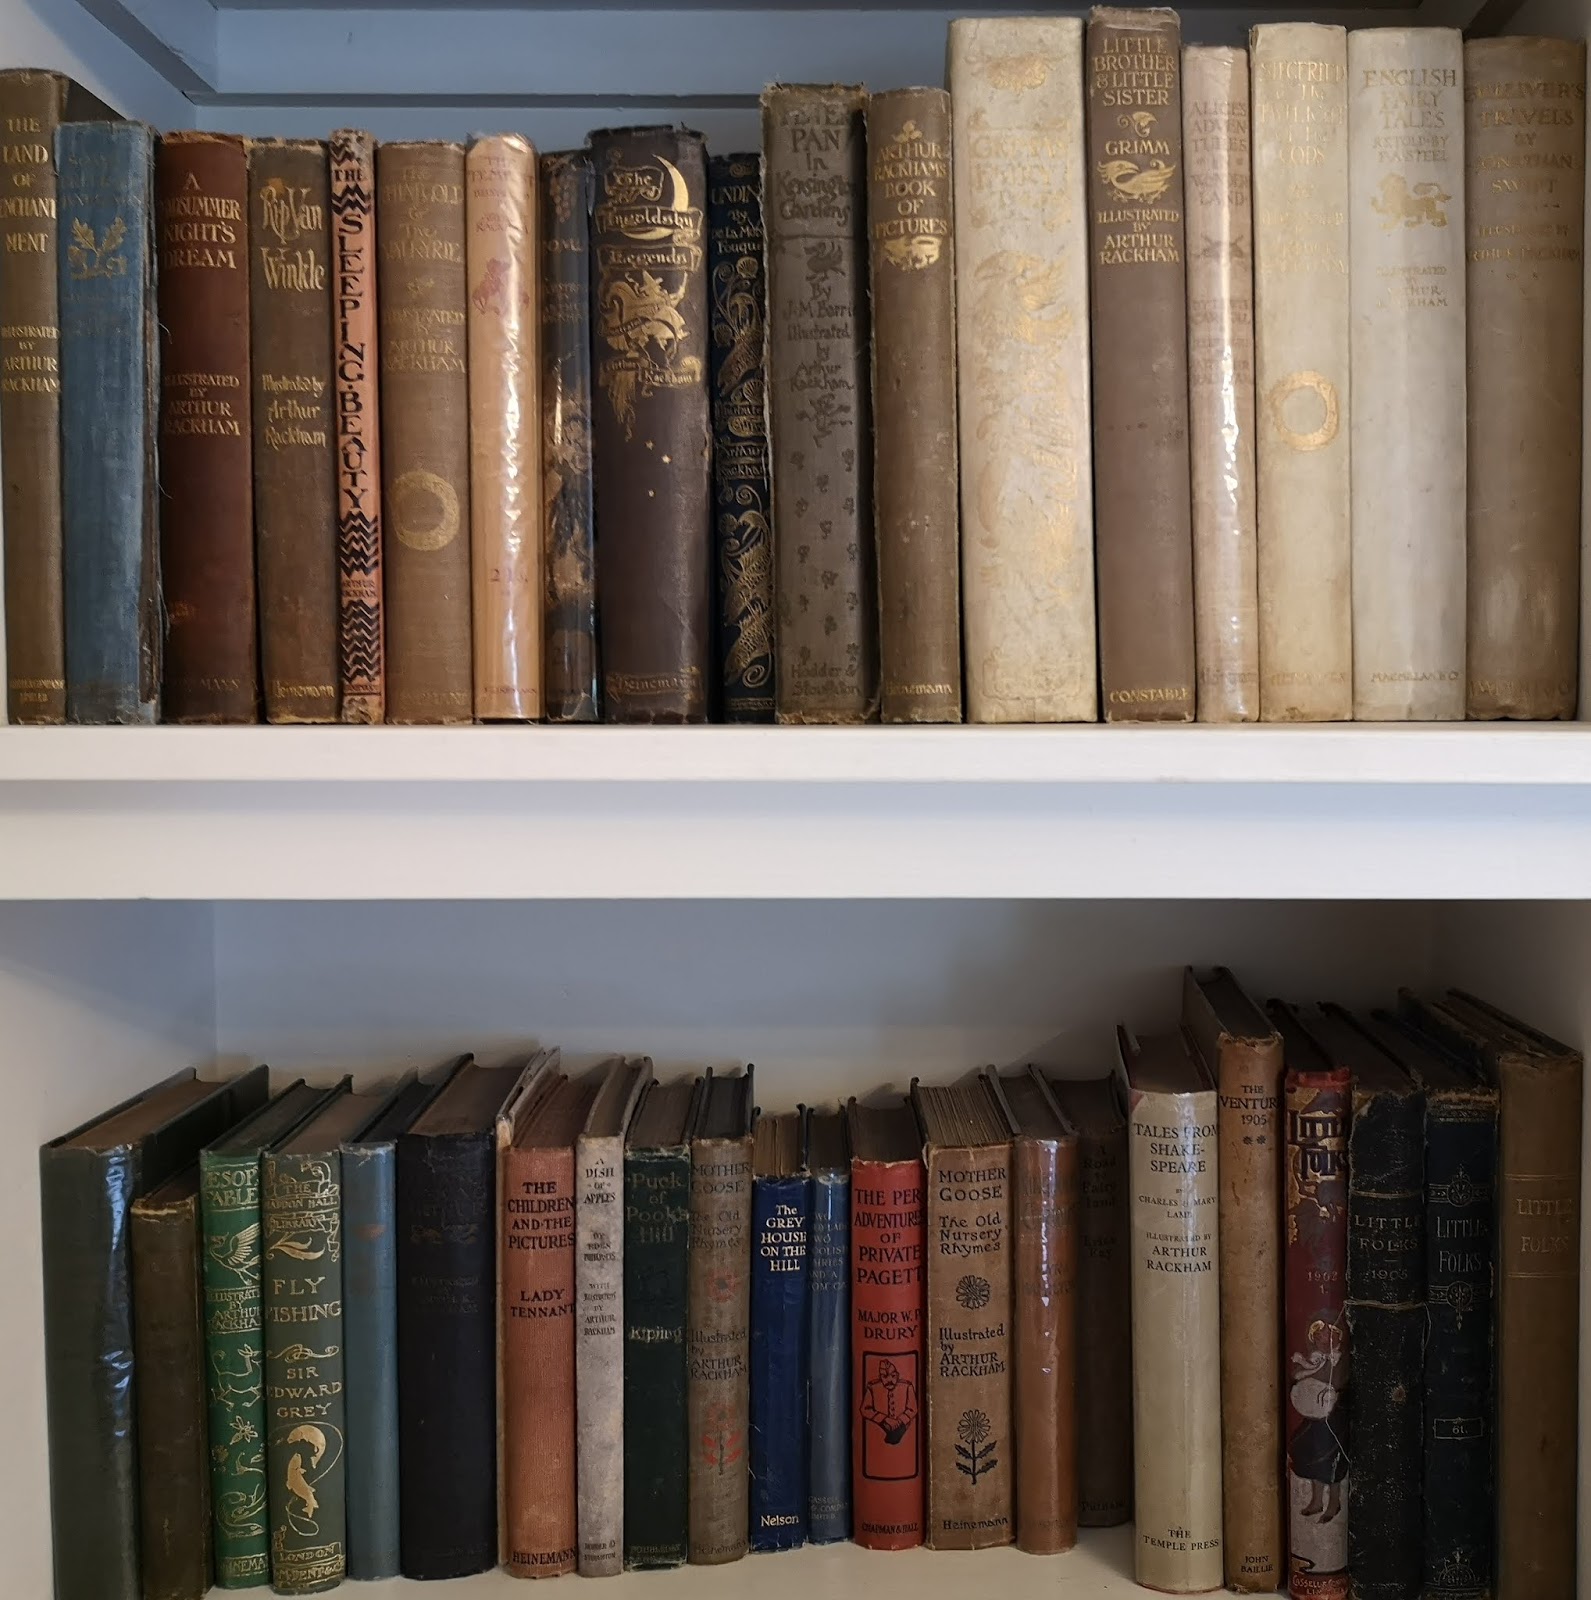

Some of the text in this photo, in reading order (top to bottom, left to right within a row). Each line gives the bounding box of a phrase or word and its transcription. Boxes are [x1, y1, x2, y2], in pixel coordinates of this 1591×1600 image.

[1103, 38, 1167, 53] LITTLE
[1095, 55, 1177, 72] BROTHER
[1112, 72, 1174, 89] LITTLE
[1363, 69, 1457, 88] ENGLISH
[1104, 89, 1169, 106] SISTER
[8, 118, 41, 133] THE
[1379, 111, 1446, 129] TALES
[791, 128, 840, 153] PAN
[1106, 140, 1170, 156] GRIMM
[12, 173, 36, 188] OF
[183, 172, 201, 191] A
[335, 168, 365, 182] THE
[711, 185, 761, 204] UNDIN
[884, 180, 936, 198] BOOK
[261, 184, 291, 245] Rip
[897, 199, 924, 216] OF
[1098, 209, 1179, 224] ILLUSTRATED
[874, 217, 949, 240] PICTURES
[717, 240, 761, 256] Fouqu
[1104, 234, 1174, 249] ARTHUR
[1101, 249, 1180, 265] RACKHAM
[260, 246, 327, 292] Winkle
[337, 213, 367, 383] SLEEPING
[267, 401, 321, 423] Arthur
[1109, 686, 1189, 704] CONSTABLE
[1241, 1084, 1264, 1095] THE
[1219, 1095, 1278, 1111] VENTUR
[1241, 1114, 1268, 1126] 1905
[1133, 1122, 1179, 1139] TALES
[1150, 1142, 1206, 1157] SHAKE-
[585, 1167, 615, 1179] DISH
[938, 1166, 1007, 1184] MOTHER
[1150, 1160, 1206, 1174] SPEARE
[522, 1181, 557, 1195] THE
[631, 1170, 685, 1190] Puck
[583, 1192, 617, 1205] APPLES
[854, 1187, 921, 1206] THE PER
[939, 1184, 1003, 1202] GOOSE
[1138, 1195, 1217, 1208] CHARLES MARY
[507, 1196, 576, 1214] CHILDREN
[776, 1204, 798, 1216] The
[512, 1216, 572, 1231] AND THE
[765, 1216, 805, 1229] GREY
[853, 1210, 922, 1230] ADVENTURE
[938, 1211, 1002, 1229] The Old
[508, 1231, 576, 1250] PICTURES
[760, 1231, 807, 1244] HOUSE
[880, 1232, 900, 1244] OF
[939, 1228, 1002, 1243] Nursery
[760, 1244, 807, 1257] ON THE
[859, 1245, 921, 1265] PRIVATE
[939, 1241, 1002, 1259] Rhymes
[1151, 1245, 1208, 1258] ARTHUR
[769, 1260, 801, 1272] HILL
[1146, 1260, 1212, 1274] RACKHAM
[1439, 1249, 1482, 1274] FOLKS
[856, 1264, 923, 1285] PAGETT
[272, 1276, 327, 1297] FLY
[520, 1288, 566, 1303] LADY
[510, 1303, 576, 1319] TENNANT
[857, 1307, 898, 1324] MAJOR
[863, 1324, 919, 1341] DRURY
[938, 1322, 1006, 1342] Illustrated
[940, 1341, 956, 1354] by
[939, 1351, 999, 1367] ARTHUR
[286, 1366, 320, 1381] SIR
[940, 1361, 1007, 1378] RACKHAM
[276, 1401, 333, 1419] GREY
[760, 1514, 800, 1528] Nelson
[942, 1517, 1009, 1531] Heinemann
[1142, 1534, 1220, 1551] TEMPLE PRESS
[1167, 1528, 1193, 1540] THE
[279, 1546, 336, 1563] LONDON
[512, 1545, 578, 1566] HEINEMANN
[1244, 1555, 1270, 1565] JOHN
